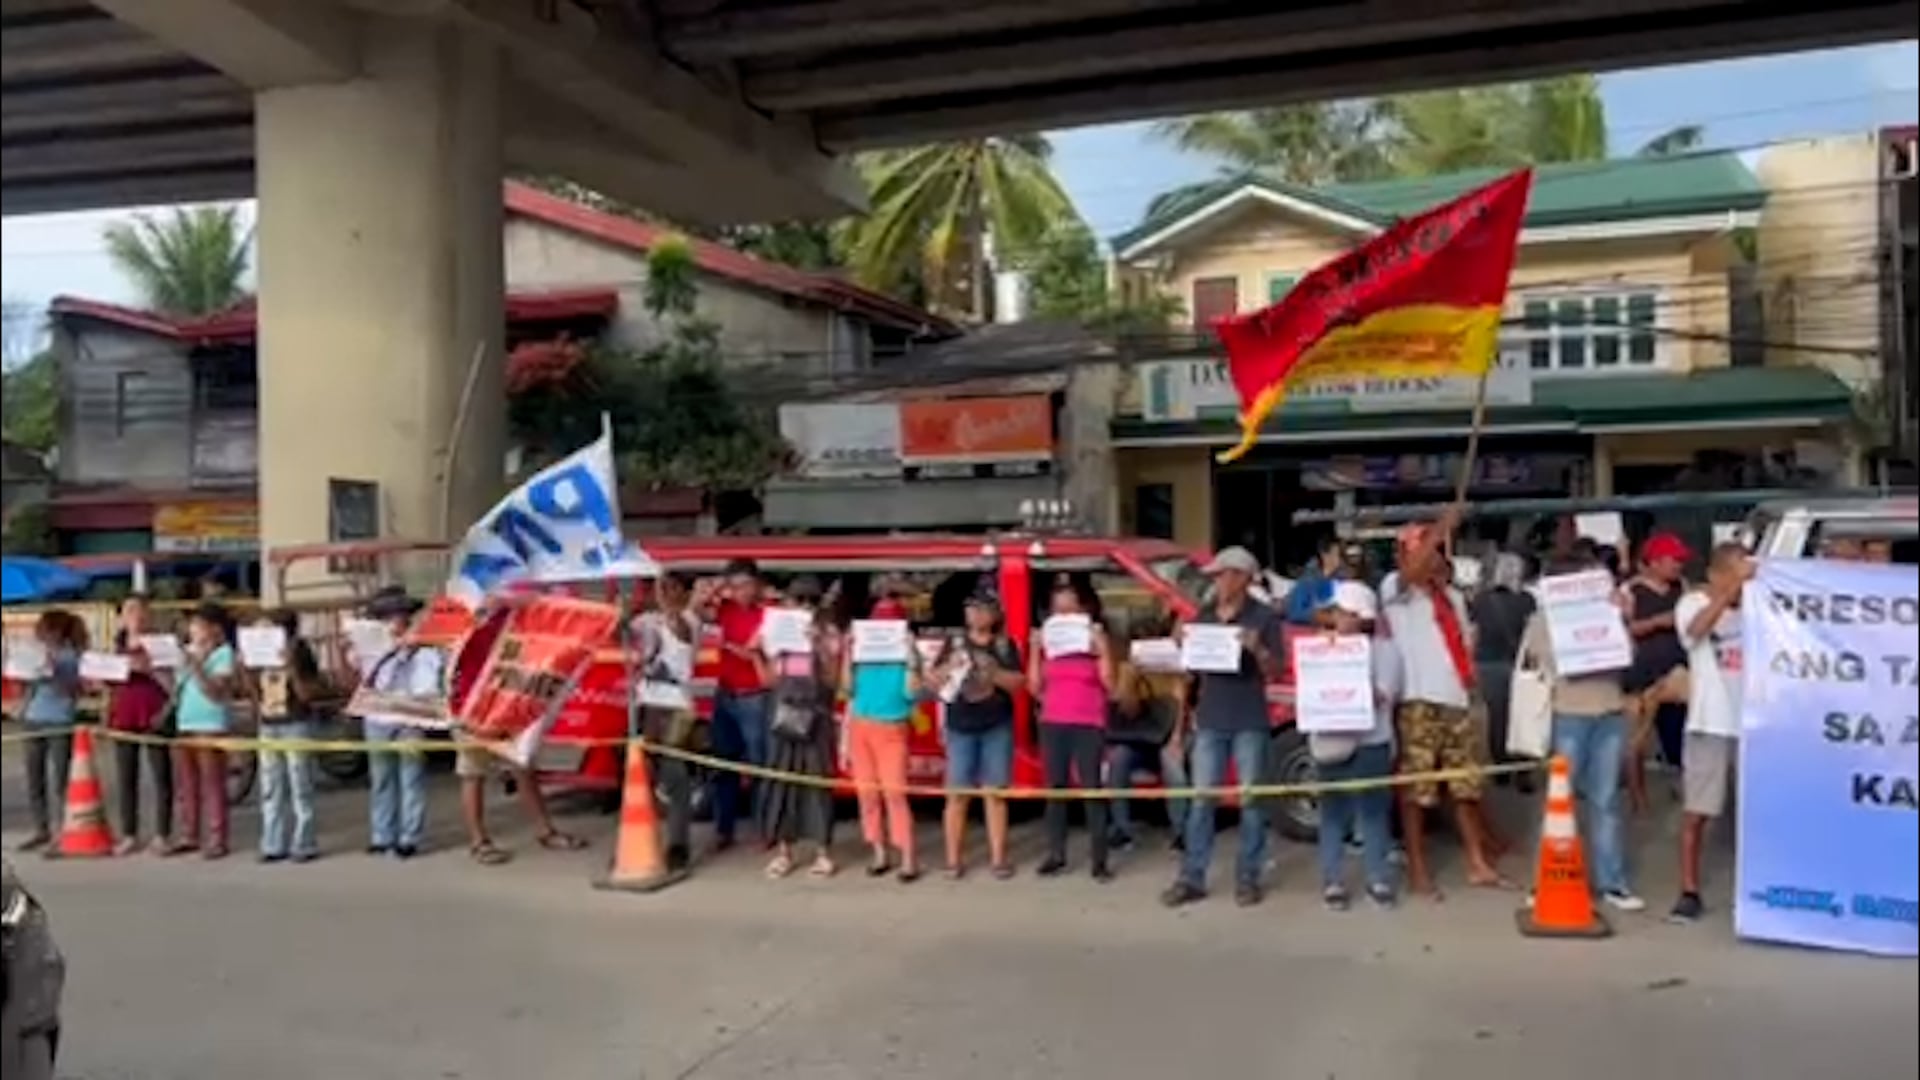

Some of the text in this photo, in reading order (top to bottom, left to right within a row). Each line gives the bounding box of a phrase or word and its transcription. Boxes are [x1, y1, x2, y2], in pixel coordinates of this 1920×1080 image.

[1769, 650, 1865, 682] ANG
[1823, 711, 1884, 746] SA
[1852, 773, 1918, 810] KA
